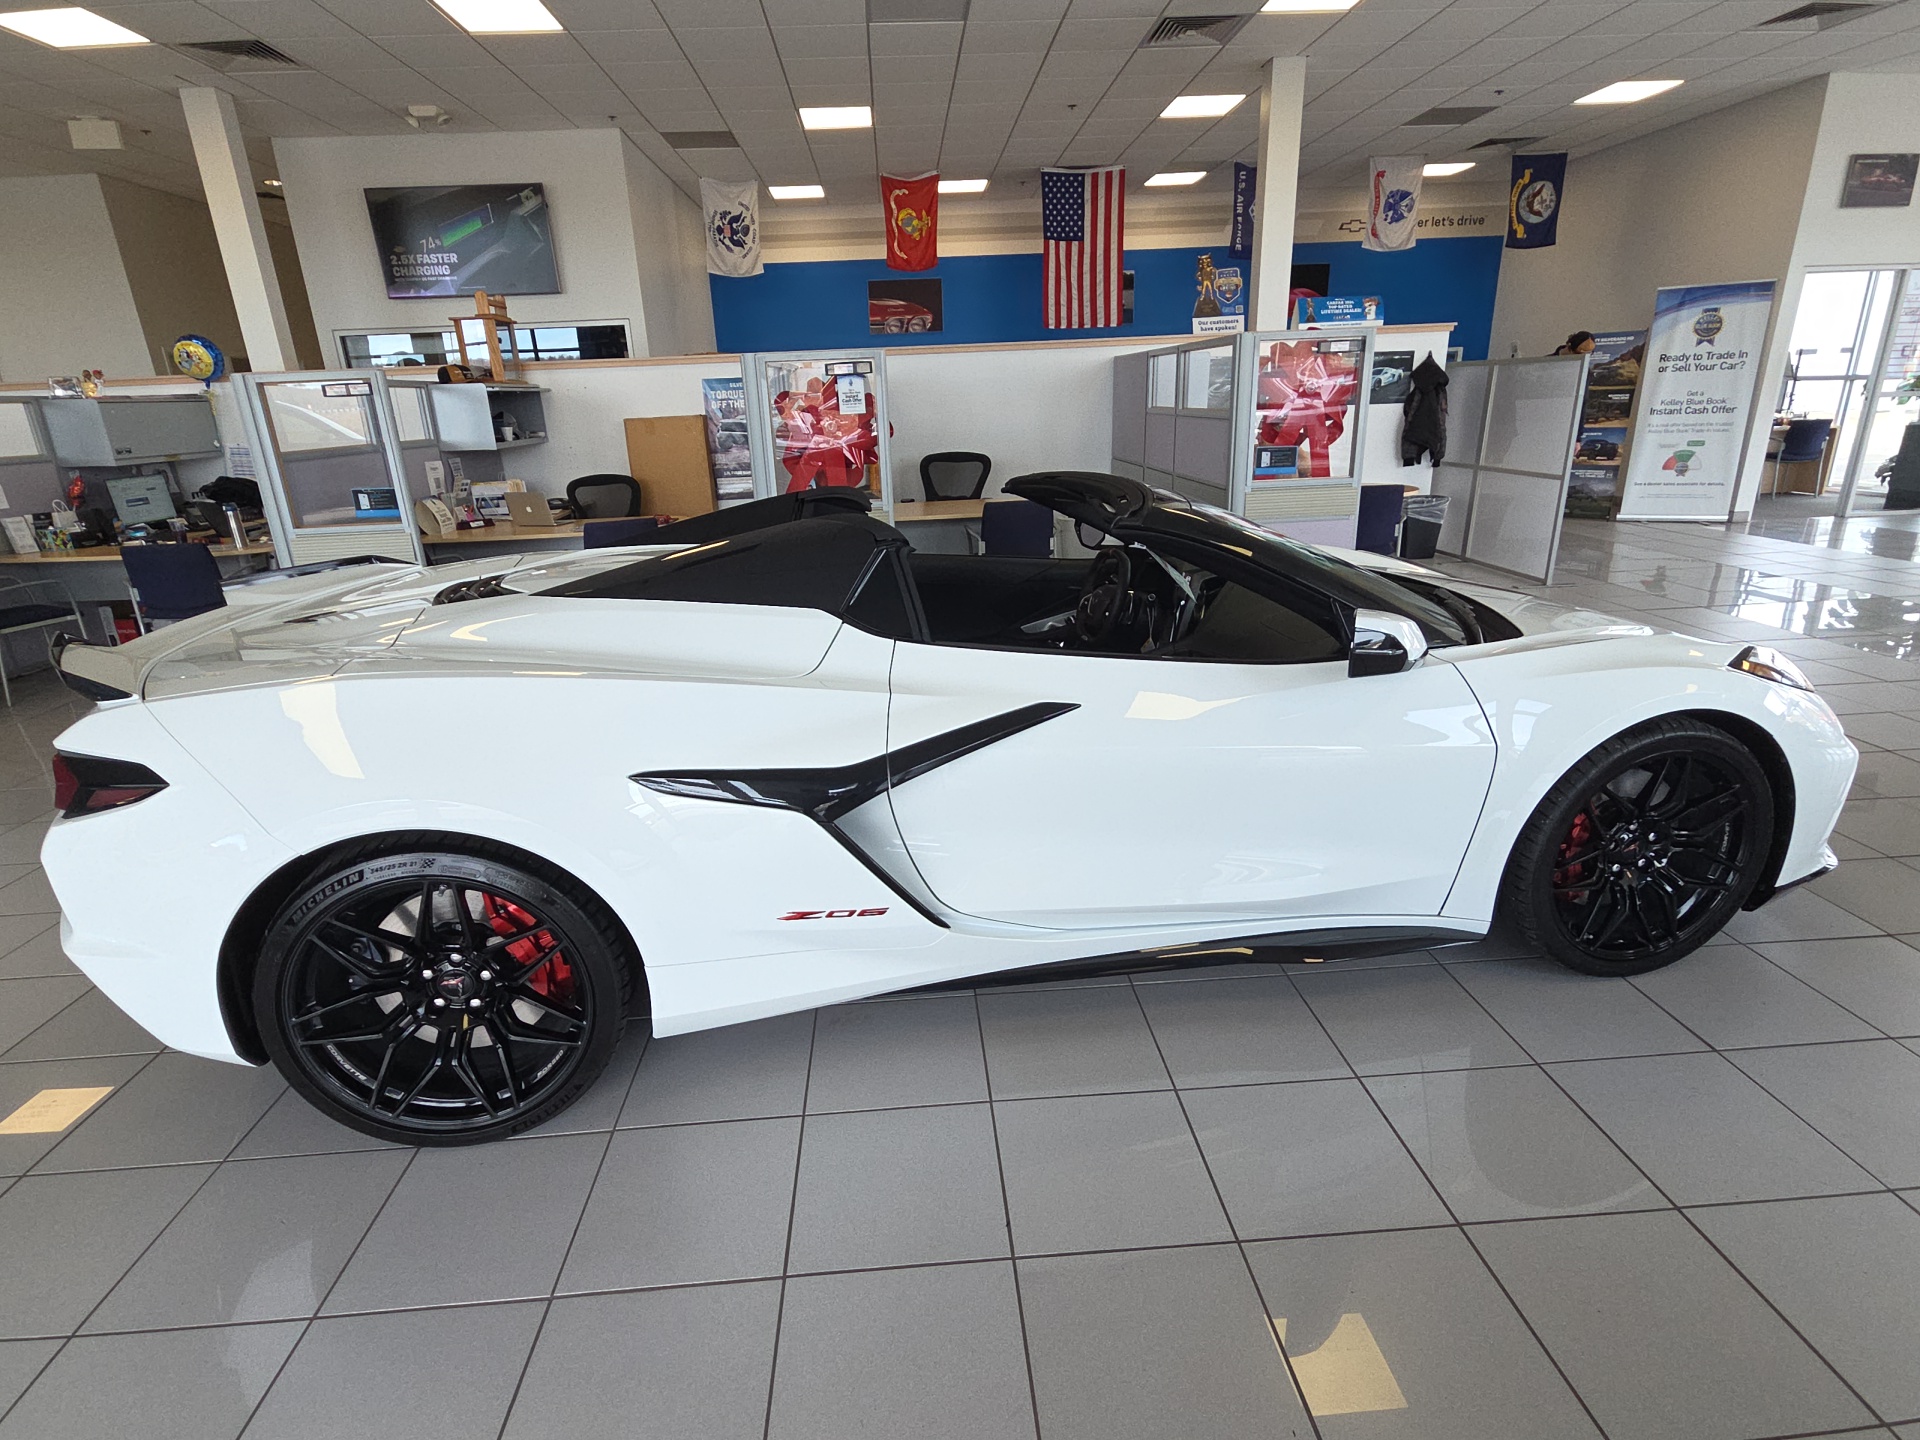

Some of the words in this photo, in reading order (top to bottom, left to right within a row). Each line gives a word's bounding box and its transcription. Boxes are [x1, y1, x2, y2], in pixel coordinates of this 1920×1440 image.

[1236, 194, 1244, 214] AIR
[1431, 216, 1454, 227] let's
[1456, 215, 1485, 226] drive
[390, 254, 416, 265] 2.5X
[416, 253, 458, 264] FASTER
[392, 265, 450, 277] CHARGING
[1659, 353, 1691, 363] Ready
[1706, 351, 1736, 360] Trade
[1738, 350, 1748, 359] In
[1671, 363, 1691, 372] Sell
[1694, 362, 1718, 371] Your
[1720, 360, 1746, 370] Car?
[710, 390, 745, 400] TORQUE
[711, 401, 728, 409] OFF
[729, 400, 746, 408] THE
[1660, 399, 1684, 408] Kelley
[1706, 397, 1727, 405] Book
[1649, 406, 1683, 416] Instant
[1684, 405, 1710, 415] Cash
[1711, 404, 1738, 414] Offer
[290, 872, 361, 923] MICHELIN
[776, 907, 890, 921] Z06
[326, 1045, 368, 1081] CORVETTE
[536, 1049, 564, 1079] FORGED
